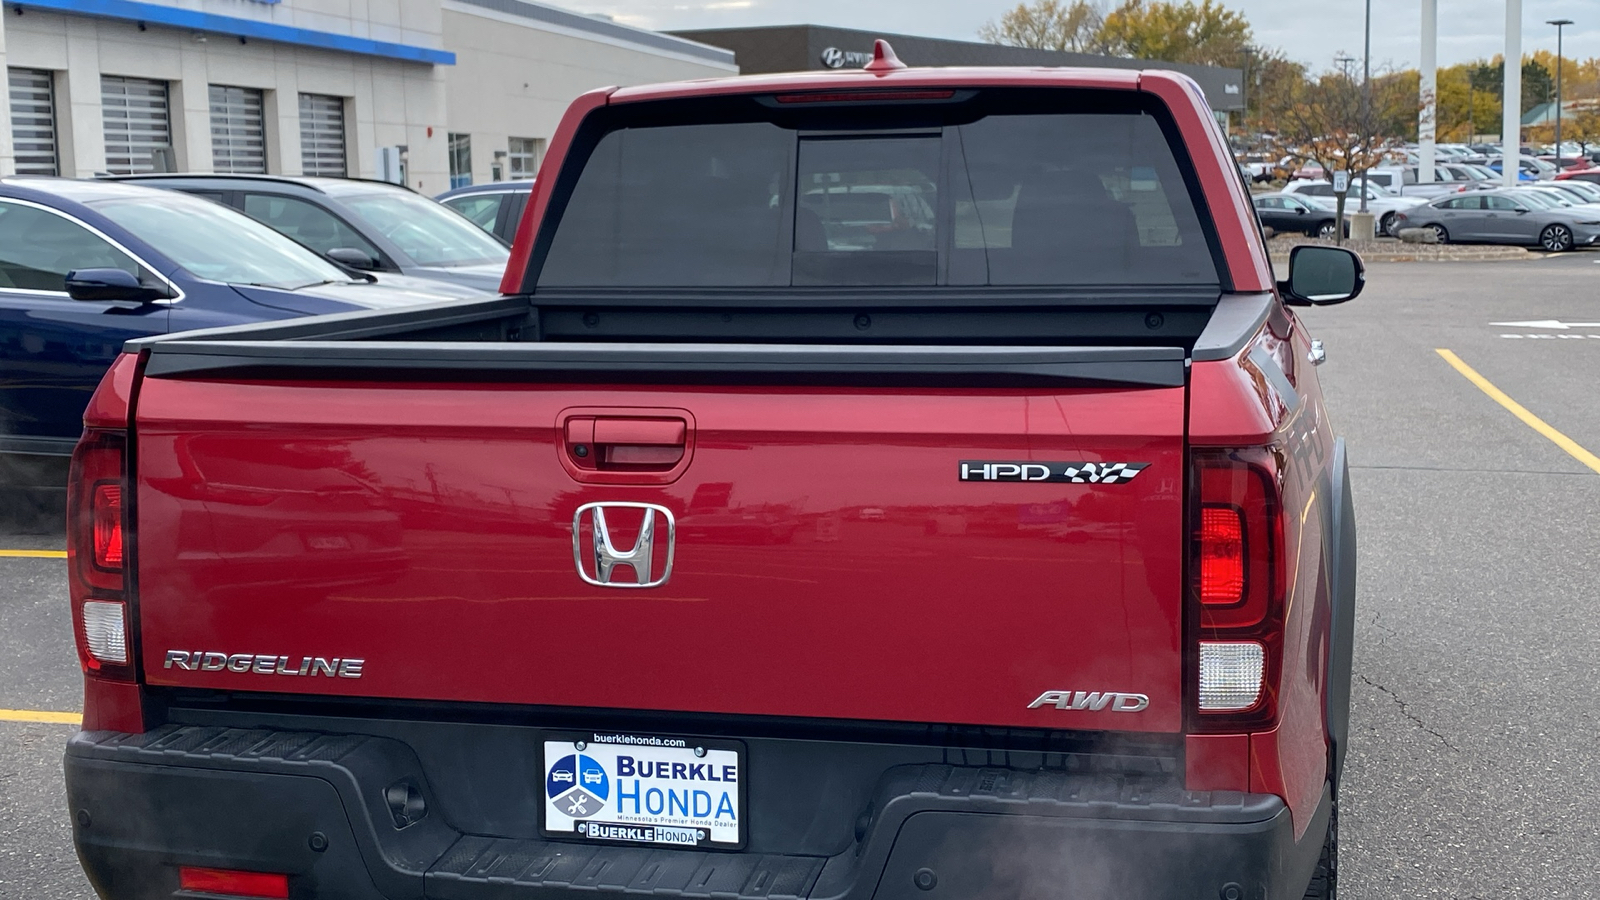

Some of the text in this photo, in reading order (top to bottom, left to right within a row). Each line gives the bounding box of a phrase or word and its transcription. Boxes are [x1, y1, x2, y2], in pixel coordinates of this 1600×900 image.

[961, 463, 1050, 481] HPD
[163, 650, 365, 678] RIDGELINE
[1026, 690, 1150, 713] AWD
[593, 733, 686, 747] buerklehonda.com
[616, 755, 737, 783] BUERKLE
[616, 778, 737, 821] HONDA
[617, 815, 737, 828] Minnesota's Premier Honda Dealer
[588, 823, 695, 844] BUERKLE HONDA
